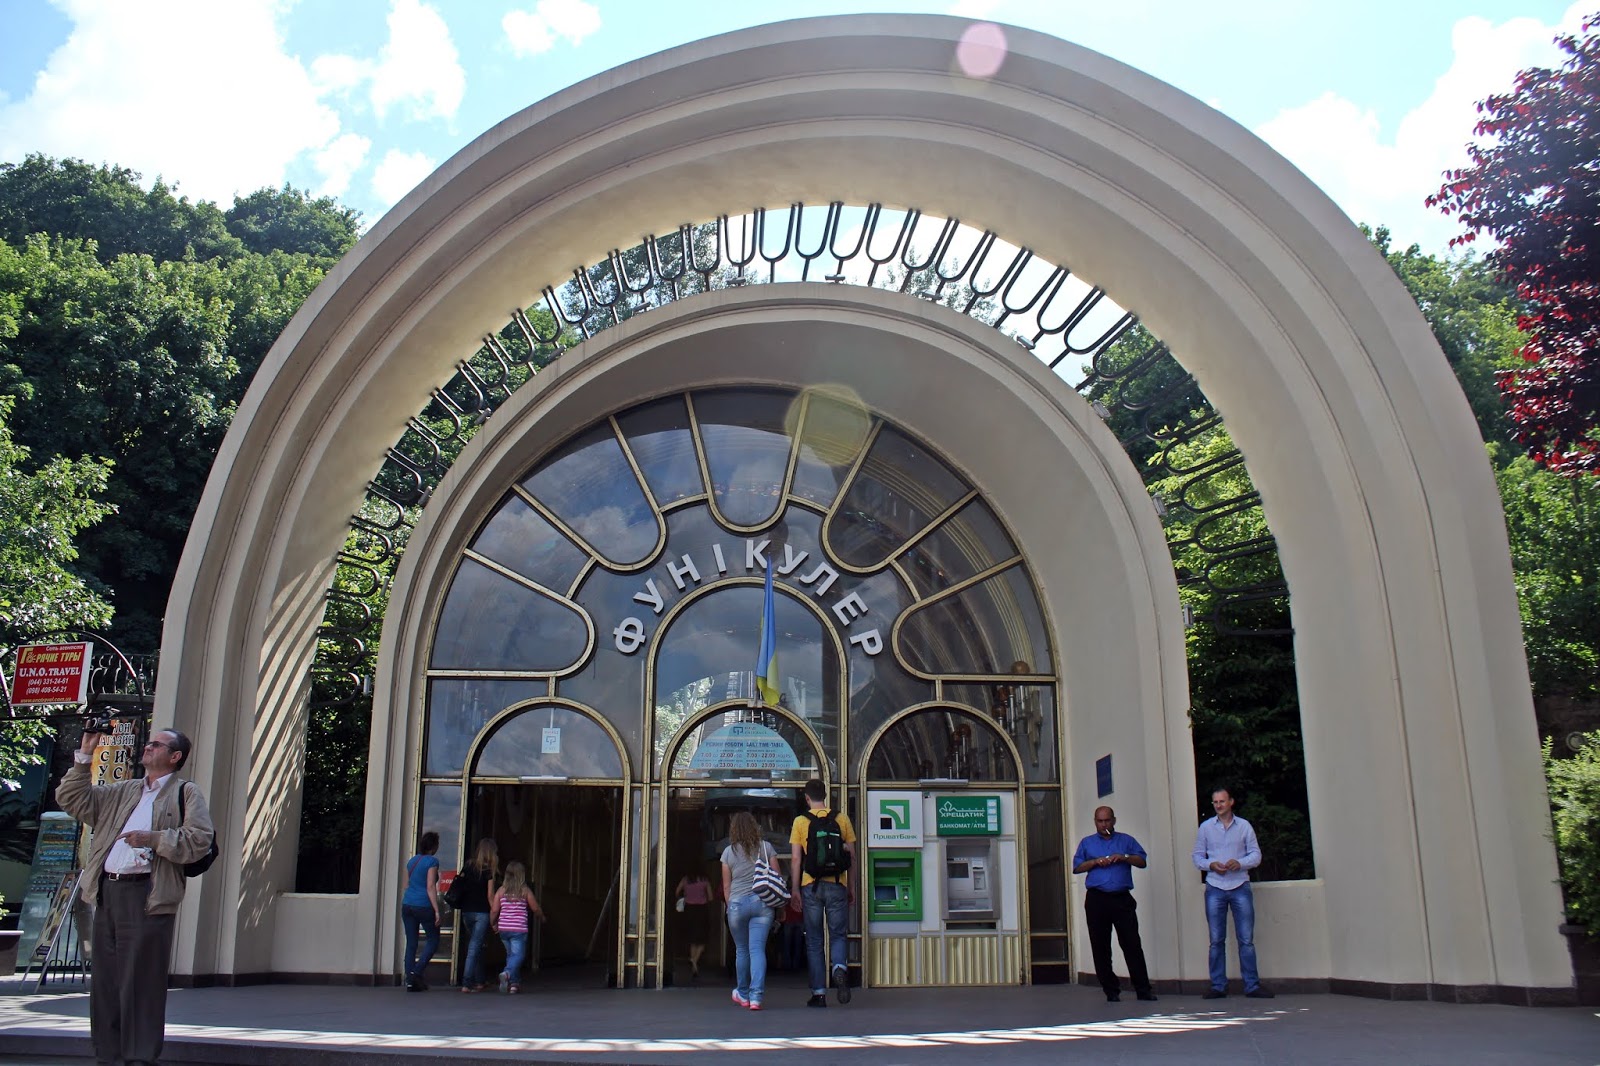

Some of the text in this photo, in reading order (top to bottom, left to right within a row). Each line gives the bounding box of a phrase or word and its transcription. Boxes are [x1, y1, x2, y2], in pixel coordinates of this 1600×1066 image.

[613, 540, 883, 655] ФУНІКУЛЕР
[60, 652, 82, 662] ТУРЫ
[98, 734, 135, 746] АГАЗИН
